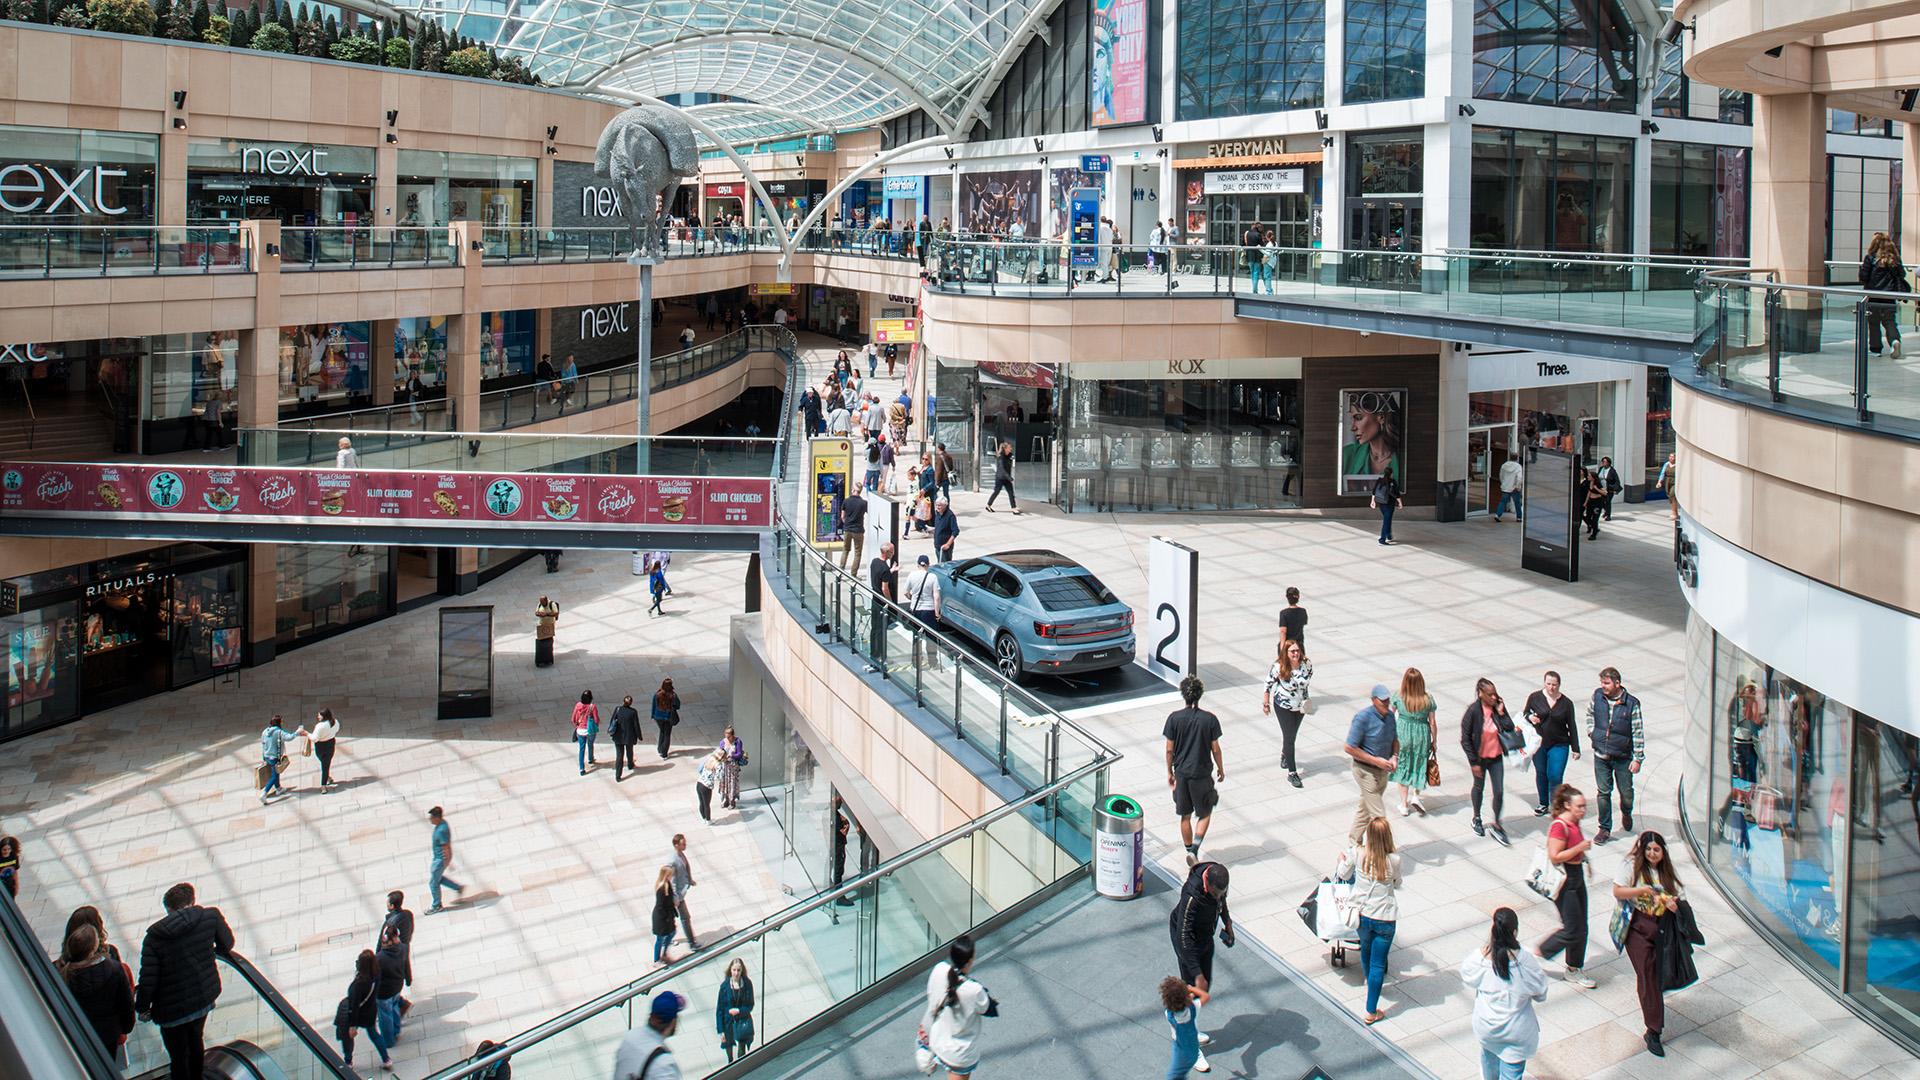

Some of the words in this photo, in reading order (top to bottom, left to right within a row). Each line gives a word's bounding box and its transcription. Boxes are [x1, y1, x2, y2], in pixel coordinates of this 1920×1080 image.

[1115, 2, 1143, 35] YORK
[1119, 31, 1143, 64] CITY
[1207, 139, 1285, 158] EVERYMAN
[242, 148, 328, 176] next
[1217, 174, 1239, 182] INDIANA
[1241, 173, 1260, 181] JONES
[1262, 172, 1274, 180] AND
[1277, 172, 1289, 180] THE
[0, 165, 128, 215] ext
[717, 186, 732, 195] COSTA
[1223, 184, 1235, 192] DIAL
[1238, 183, 1246, 191] OF
[1249, 183, 1273, 191] DESTINY
[217, 195, 239, 204] PAY
[240, 195, 270, 205] HERE
[582, 185, 624, 217] nex
[581, 302, 630, 340] next
[0, 344, 48, 363] xt
[1166, 359, 1207, 375] ROX
[1536, 361, 1570, 377] Three.
[1346, 391, 1396, 414] ROX
[101, 474, 120, 482] WINGS
[317, 480, 351, 488] SANDWICHES
[330, 473, 352, 481] Chicken
[437, 481, 457, 489] WINGS
[671, 480, 693, 488] Chicken
[36, 475, 74, 501] Fresh
[258, 481, 297, 506] Fresh
[366, 489, 383, 498] SLIM
[384, 489, 413, 498] CHICKENS
[549, 485, 573, 493] TENDERS
[657, 486, 692, 495] SANDWICHES
[598, 489, 637, 515] Fresh
[709, 492, 728, 503] SLIM
[729, 493, 762, 503] CHICKENS
[86, 573, 176, 597] RITUALS...
[15, 625, 51, 643] SALE
[1156, 602, 1181, 674] 2
[1100, 838, 1127, 848] OPENING
